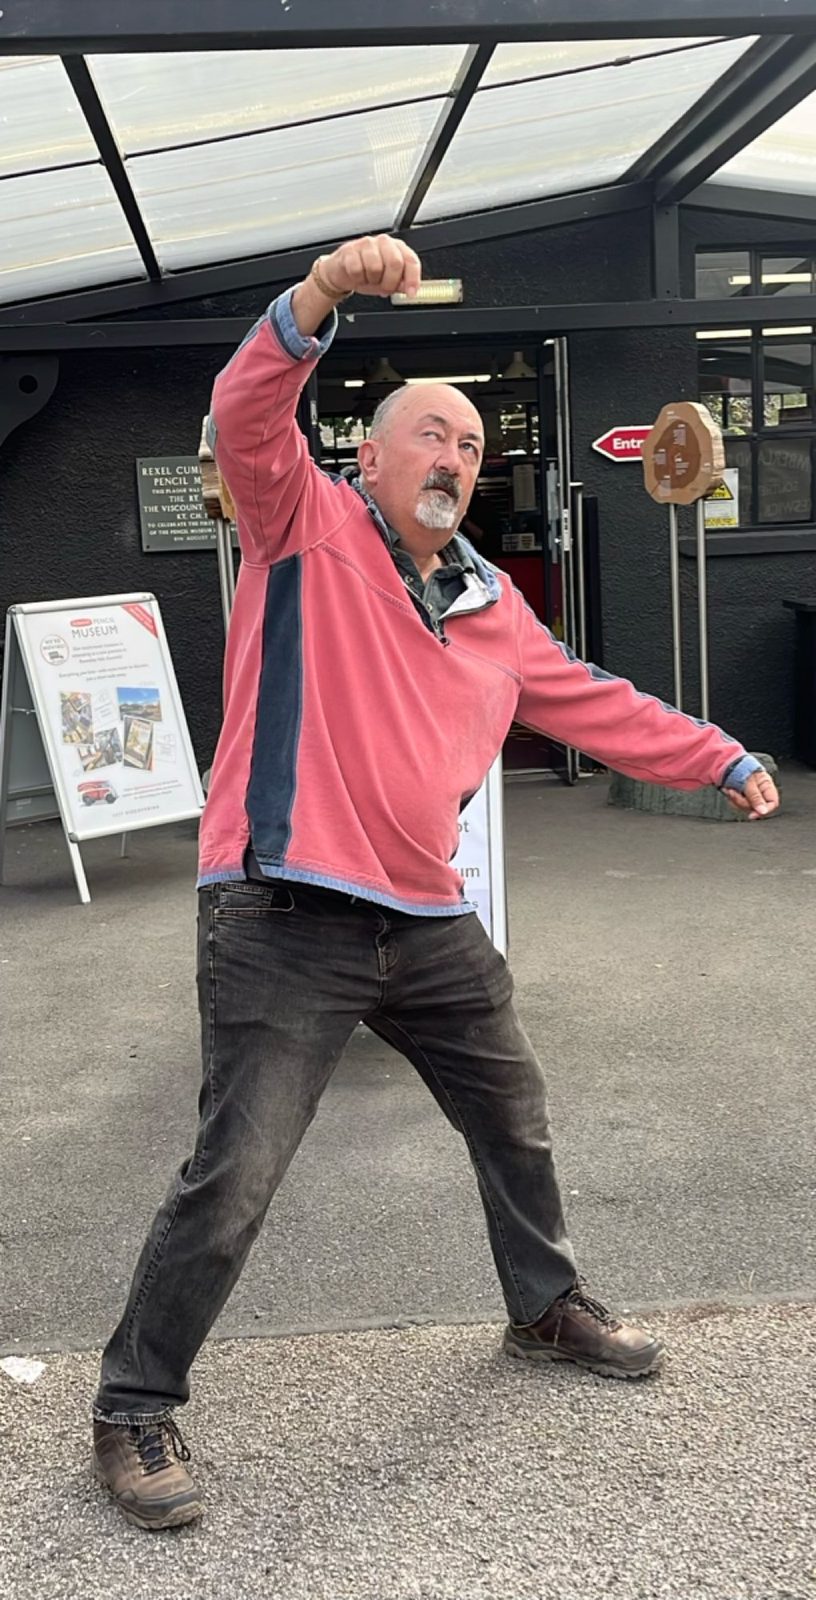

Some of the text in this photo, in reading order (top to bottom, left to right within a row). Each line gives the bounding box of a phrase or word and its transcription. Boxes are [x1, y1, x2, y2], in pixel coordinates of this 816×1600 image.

[613, 438, 645, 450] Entr
[142, 466, 172, 476] REXEL
[154, 477, 188, 486] PENCIL
[144, 503, 203, 513] THE VISCOUNT
[93, 617, 115, 625] PENCIL
[71, 625, 119, 639] MUSEUM
